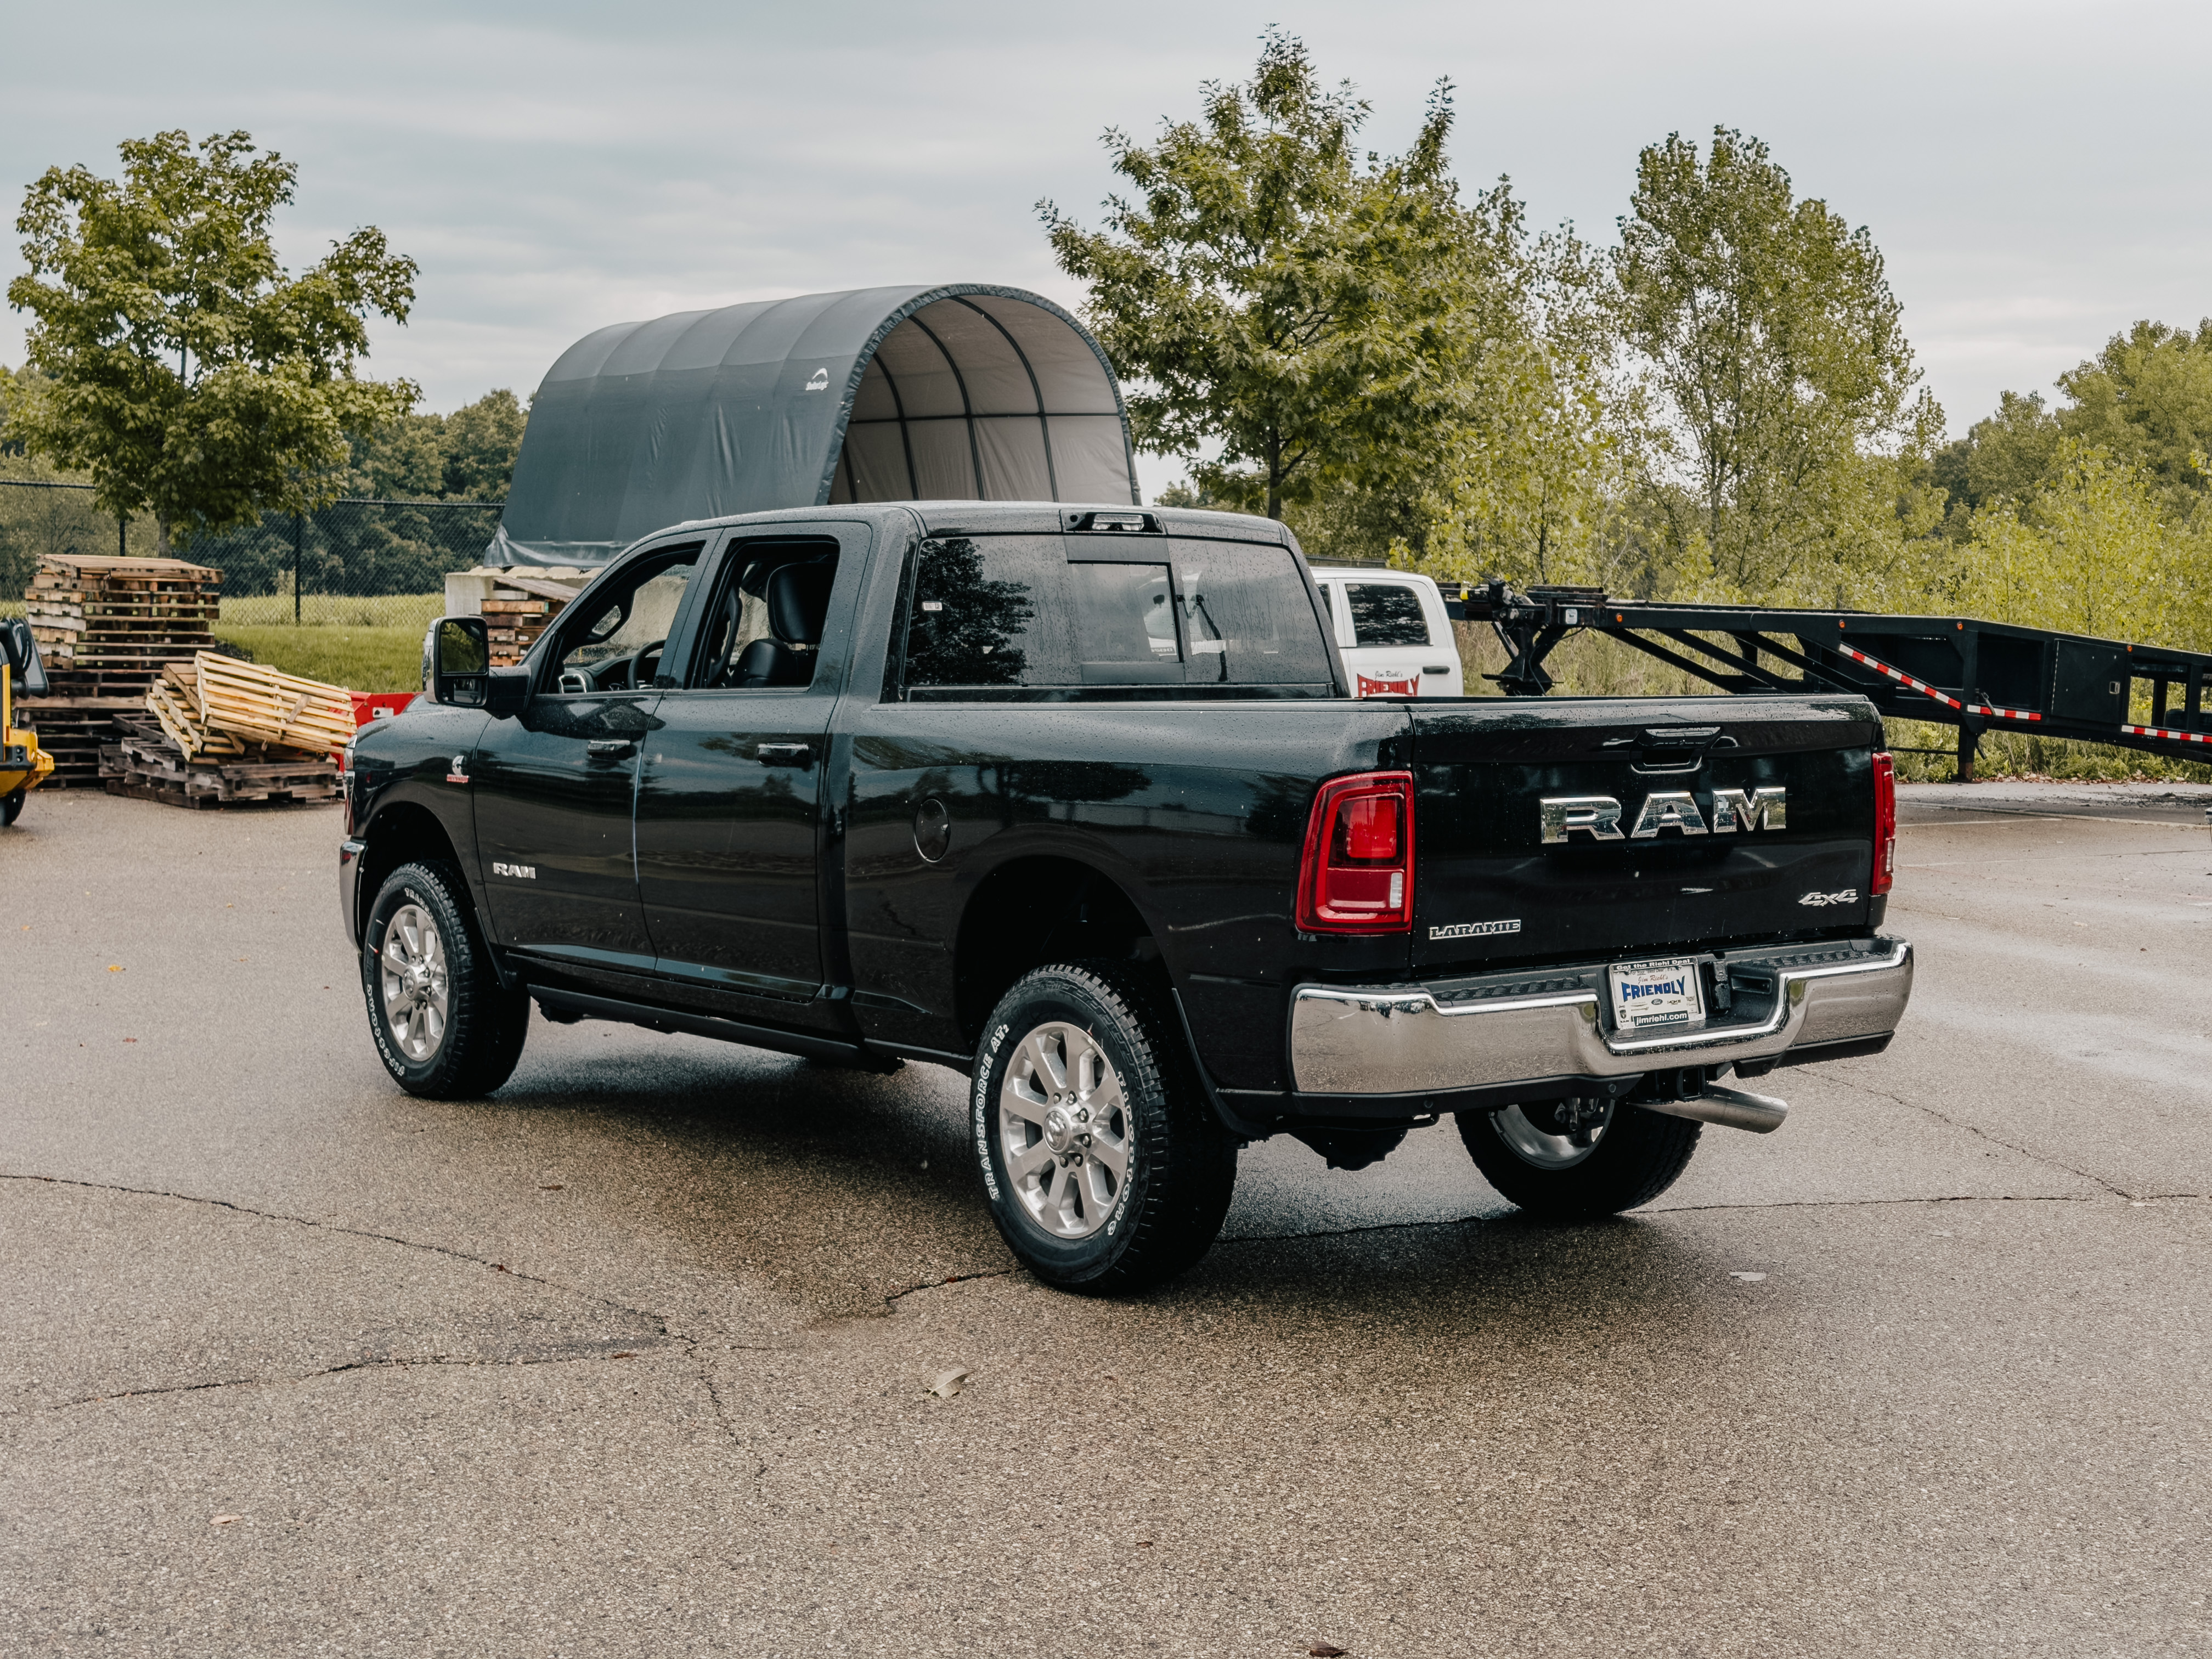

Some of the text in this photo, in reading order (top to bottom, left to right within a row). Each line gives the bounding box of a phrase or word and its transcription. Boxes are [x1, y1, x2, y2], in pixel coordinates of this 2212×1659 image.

[1357, 673, 1420, 697] FRIENDLY
[1540, 787, 1786, 843] RAM
[493, 862, 536, 879] RAM
[1798, 889, 1858, 906] 4x4
[1430, 919, 1521, 940] LARAMIE
[1621, 975, 1685, 1002] FRIENDLY
[1638, 974, 1668, 984] Jim Riehl's
[1636, 1013, 1687, 1026] jimriehl.com
[976, 1053, 1000, 1200] TRANSFORCE
